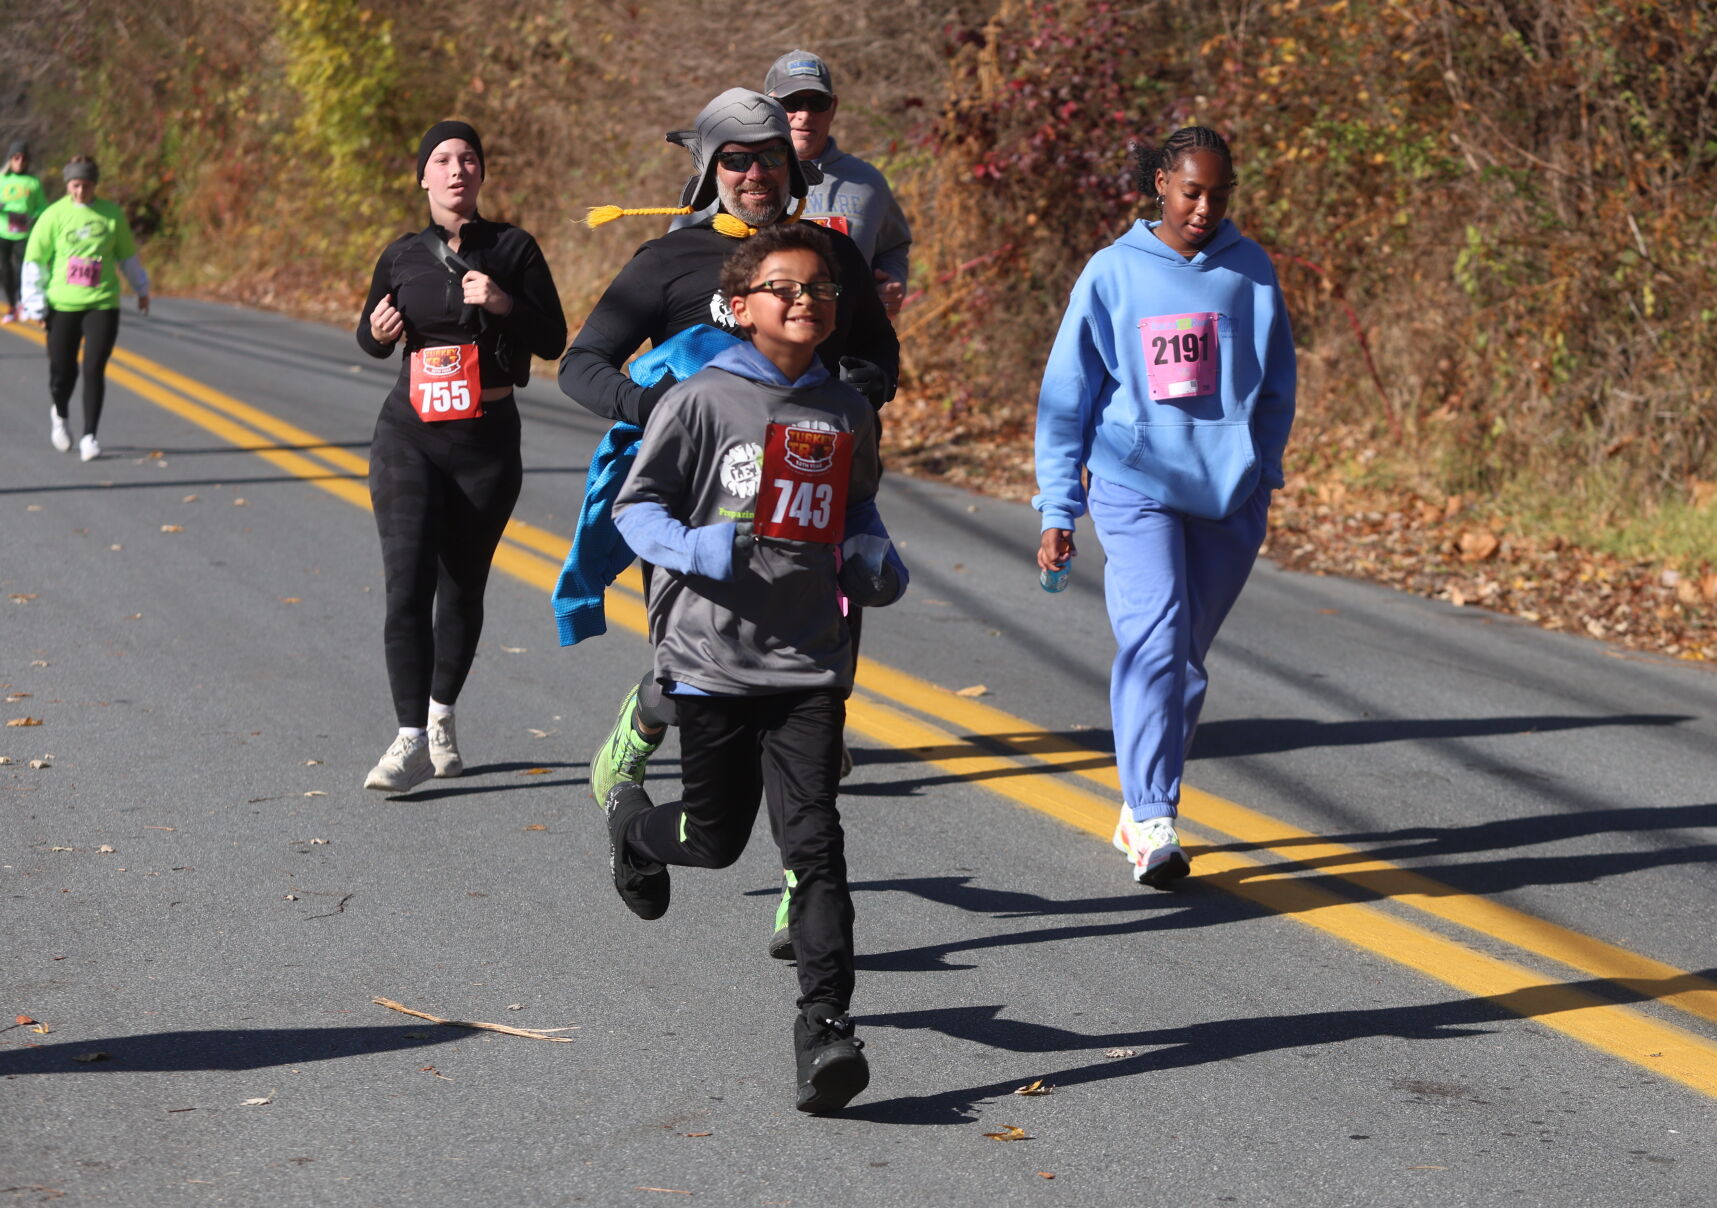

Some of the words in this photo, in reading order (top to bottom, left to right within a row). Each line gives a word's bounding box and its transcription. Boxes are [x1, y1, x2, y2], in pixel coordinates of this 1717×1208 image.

[1152, 333, 1208, 365] 2191
[418, 380, 471, 414] 755
[789, 431, 834, 443] TURKEY
[771, 479, 833, 529] 743
